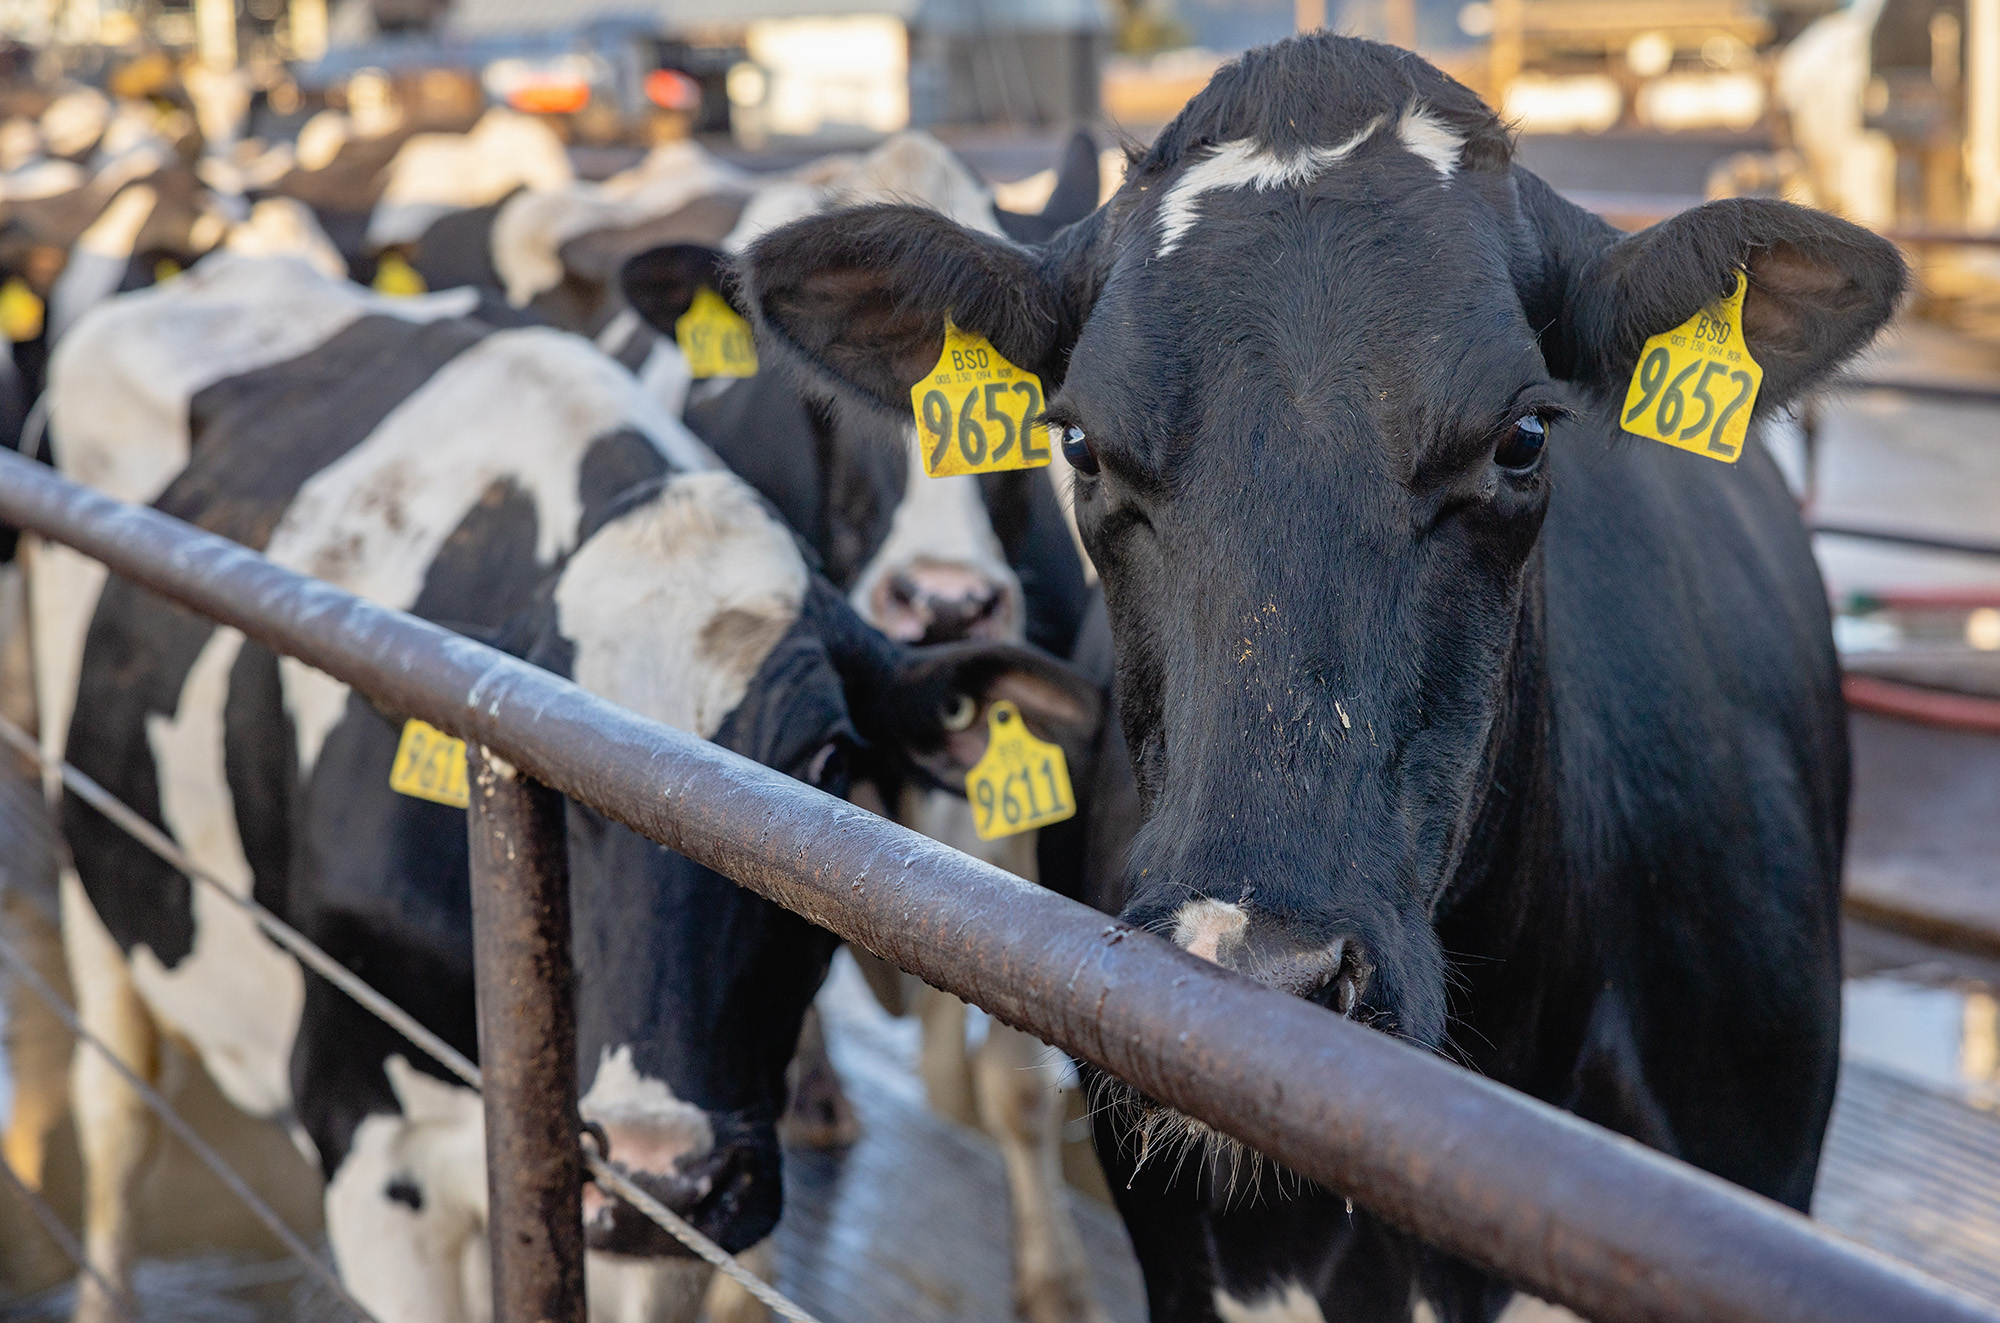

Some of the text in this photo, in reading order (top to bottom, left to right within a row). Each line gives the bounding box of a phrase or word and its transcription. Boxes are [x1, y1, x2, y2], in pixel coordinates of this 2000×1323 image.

[951, 348, 989, 371] BSD
[1695, 316, 1731, 345] BSD
[922, 381, 1050, 474] 9652
[1624, 347, 1753, 457] 9652
[976, 757, 1066, 831] 9611
